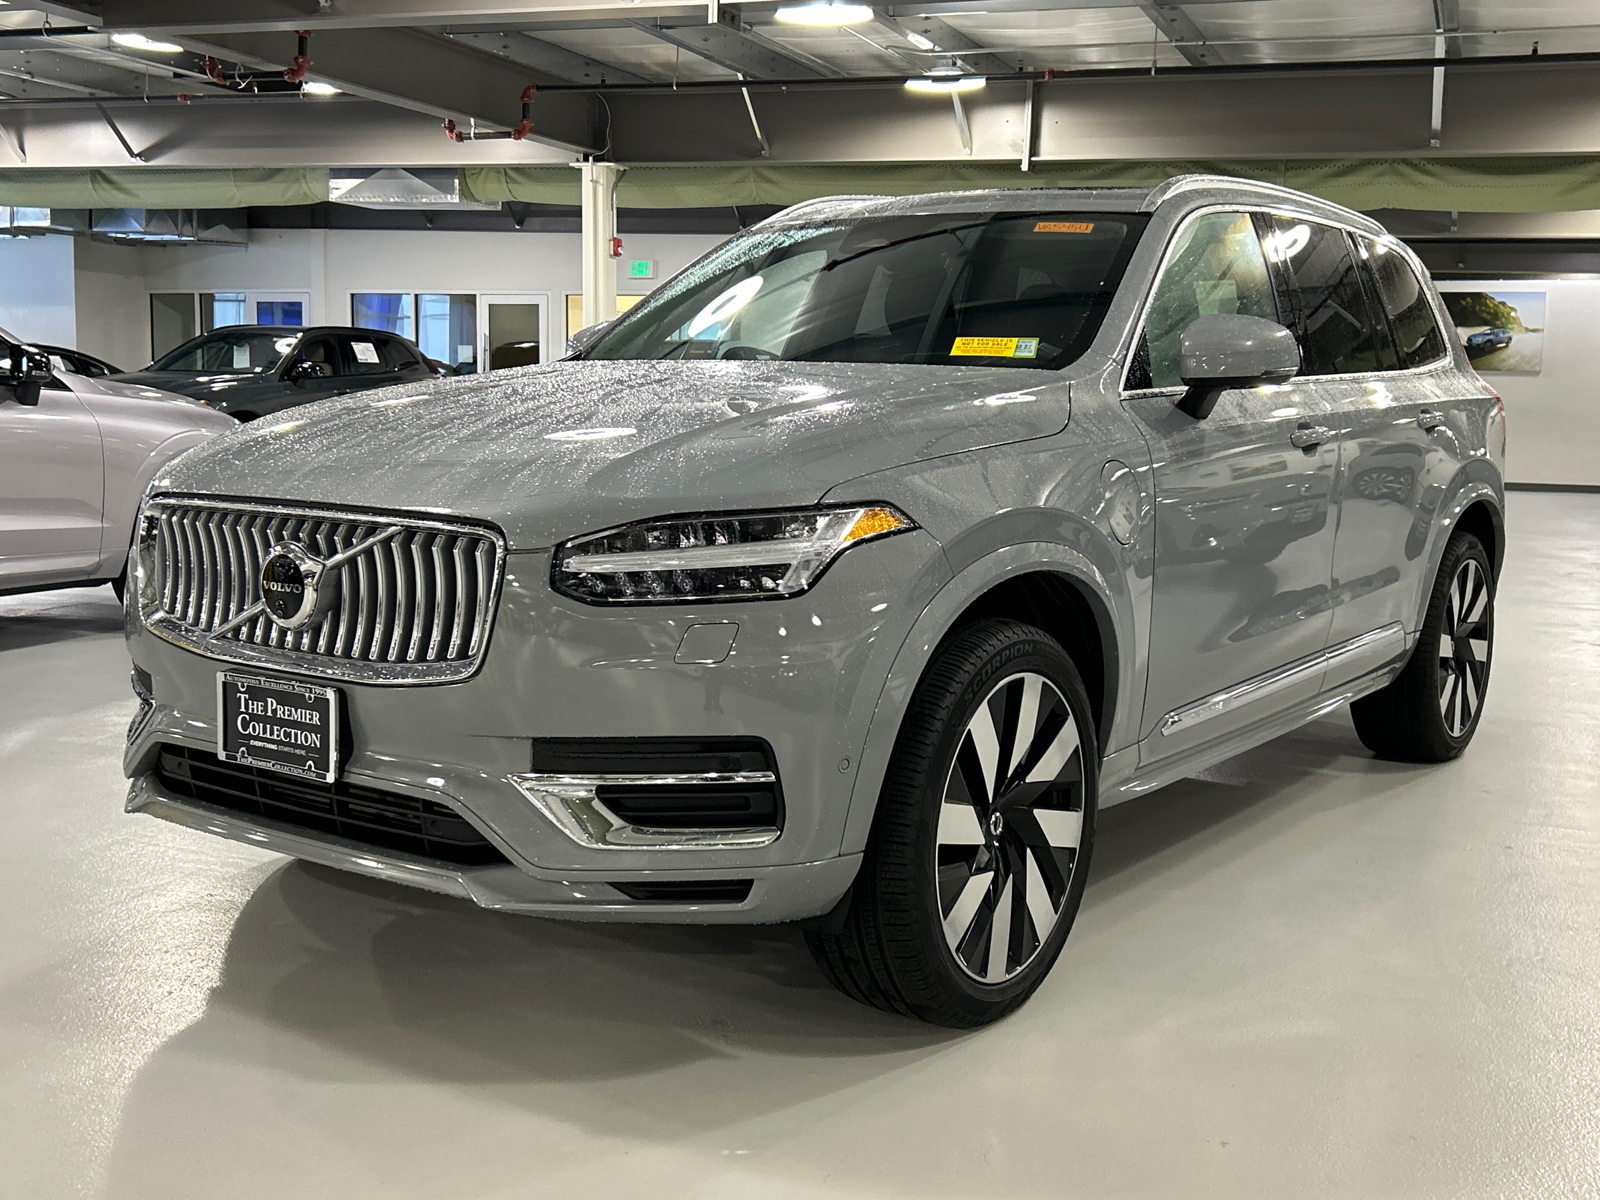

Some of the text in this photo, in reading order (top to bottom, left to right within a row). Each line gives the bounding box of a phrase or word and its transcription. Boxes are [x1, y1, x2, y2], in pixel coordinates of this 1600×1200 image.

[632, 261, 648, 275] EXIT
[263, 580, 302, 594] VOLVO
[964, 643, 1034, 706] SCORPION
[261, 680, 293, 691] EXCELLENCE
[294, 685, 310, 693] SINCE
[237, 693, 321, 726] THE PREMIER
[237, 714, 320, 748] COLLECTION
[250, 740, 278, 750] EVERYTHING
[278, 745, 294, 753] STARTS
